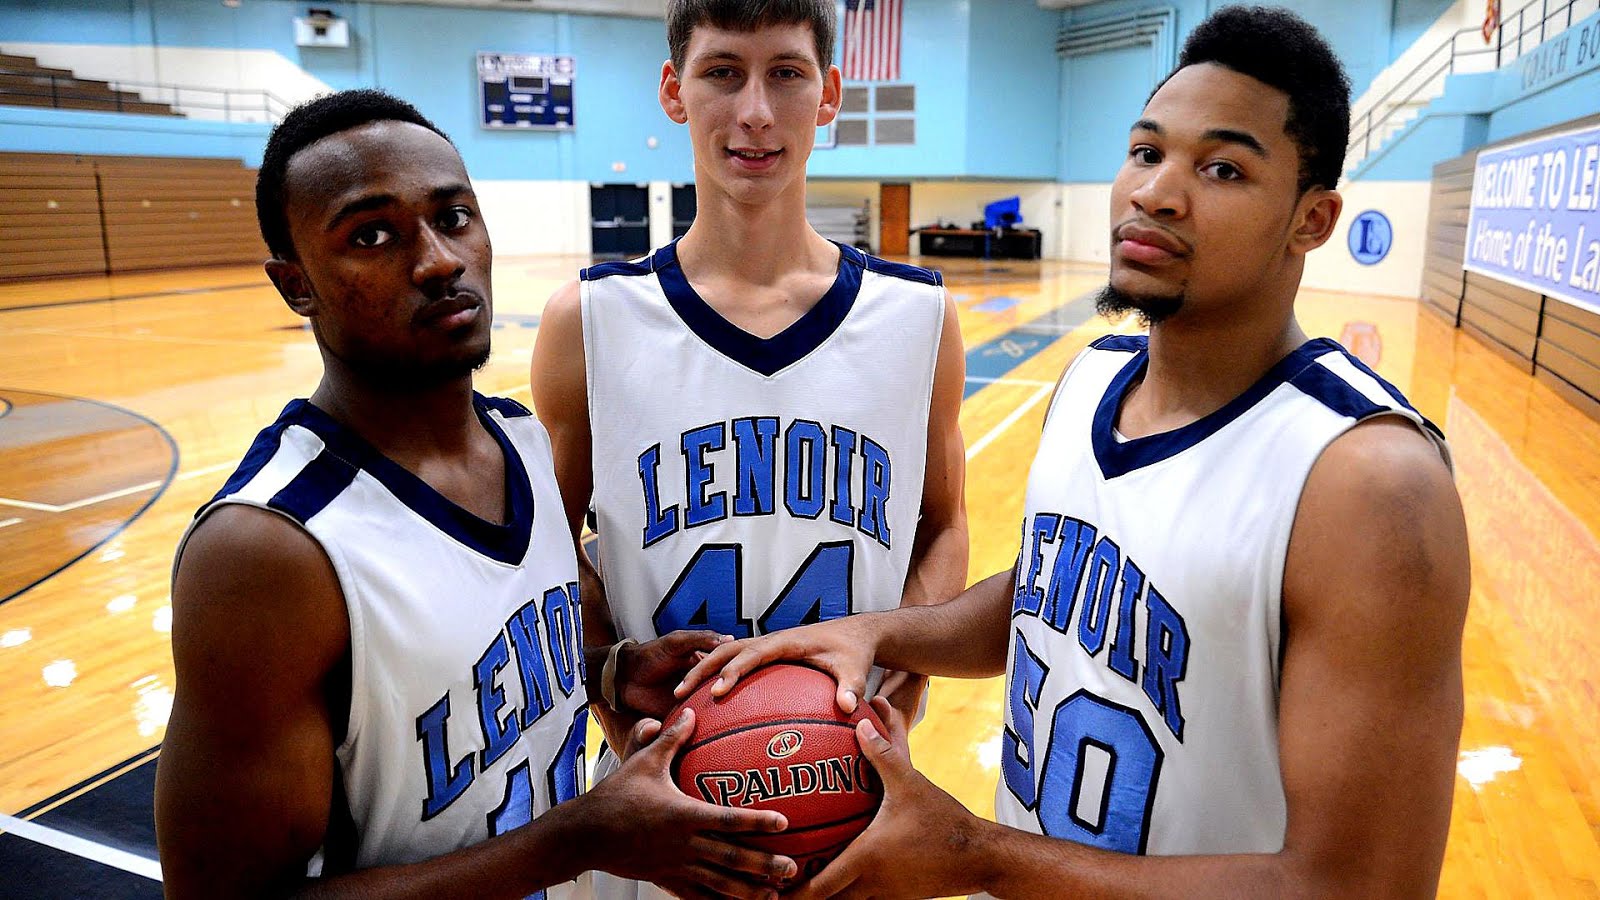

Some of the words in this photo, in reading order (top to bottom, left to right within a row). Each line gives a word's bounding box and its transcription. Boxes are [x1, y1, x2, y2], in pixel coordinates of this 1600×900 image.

[1521, 36, 1569, 90] COACH
[1474, 154, 1539, 208] WELCOME
[1539, 149, 1567, 209] TO
[1472, 217, 1512, 267] Home
[1514, 219, 1536, 271] of
[1533, 223, 1568, 282] the
[638, 416, 892, 550] LENOIR
[652, 540, 860, 638] 44
[1011, 512, 1190, 744] LENOIR
[1001, 626, 1165, 856] 50
